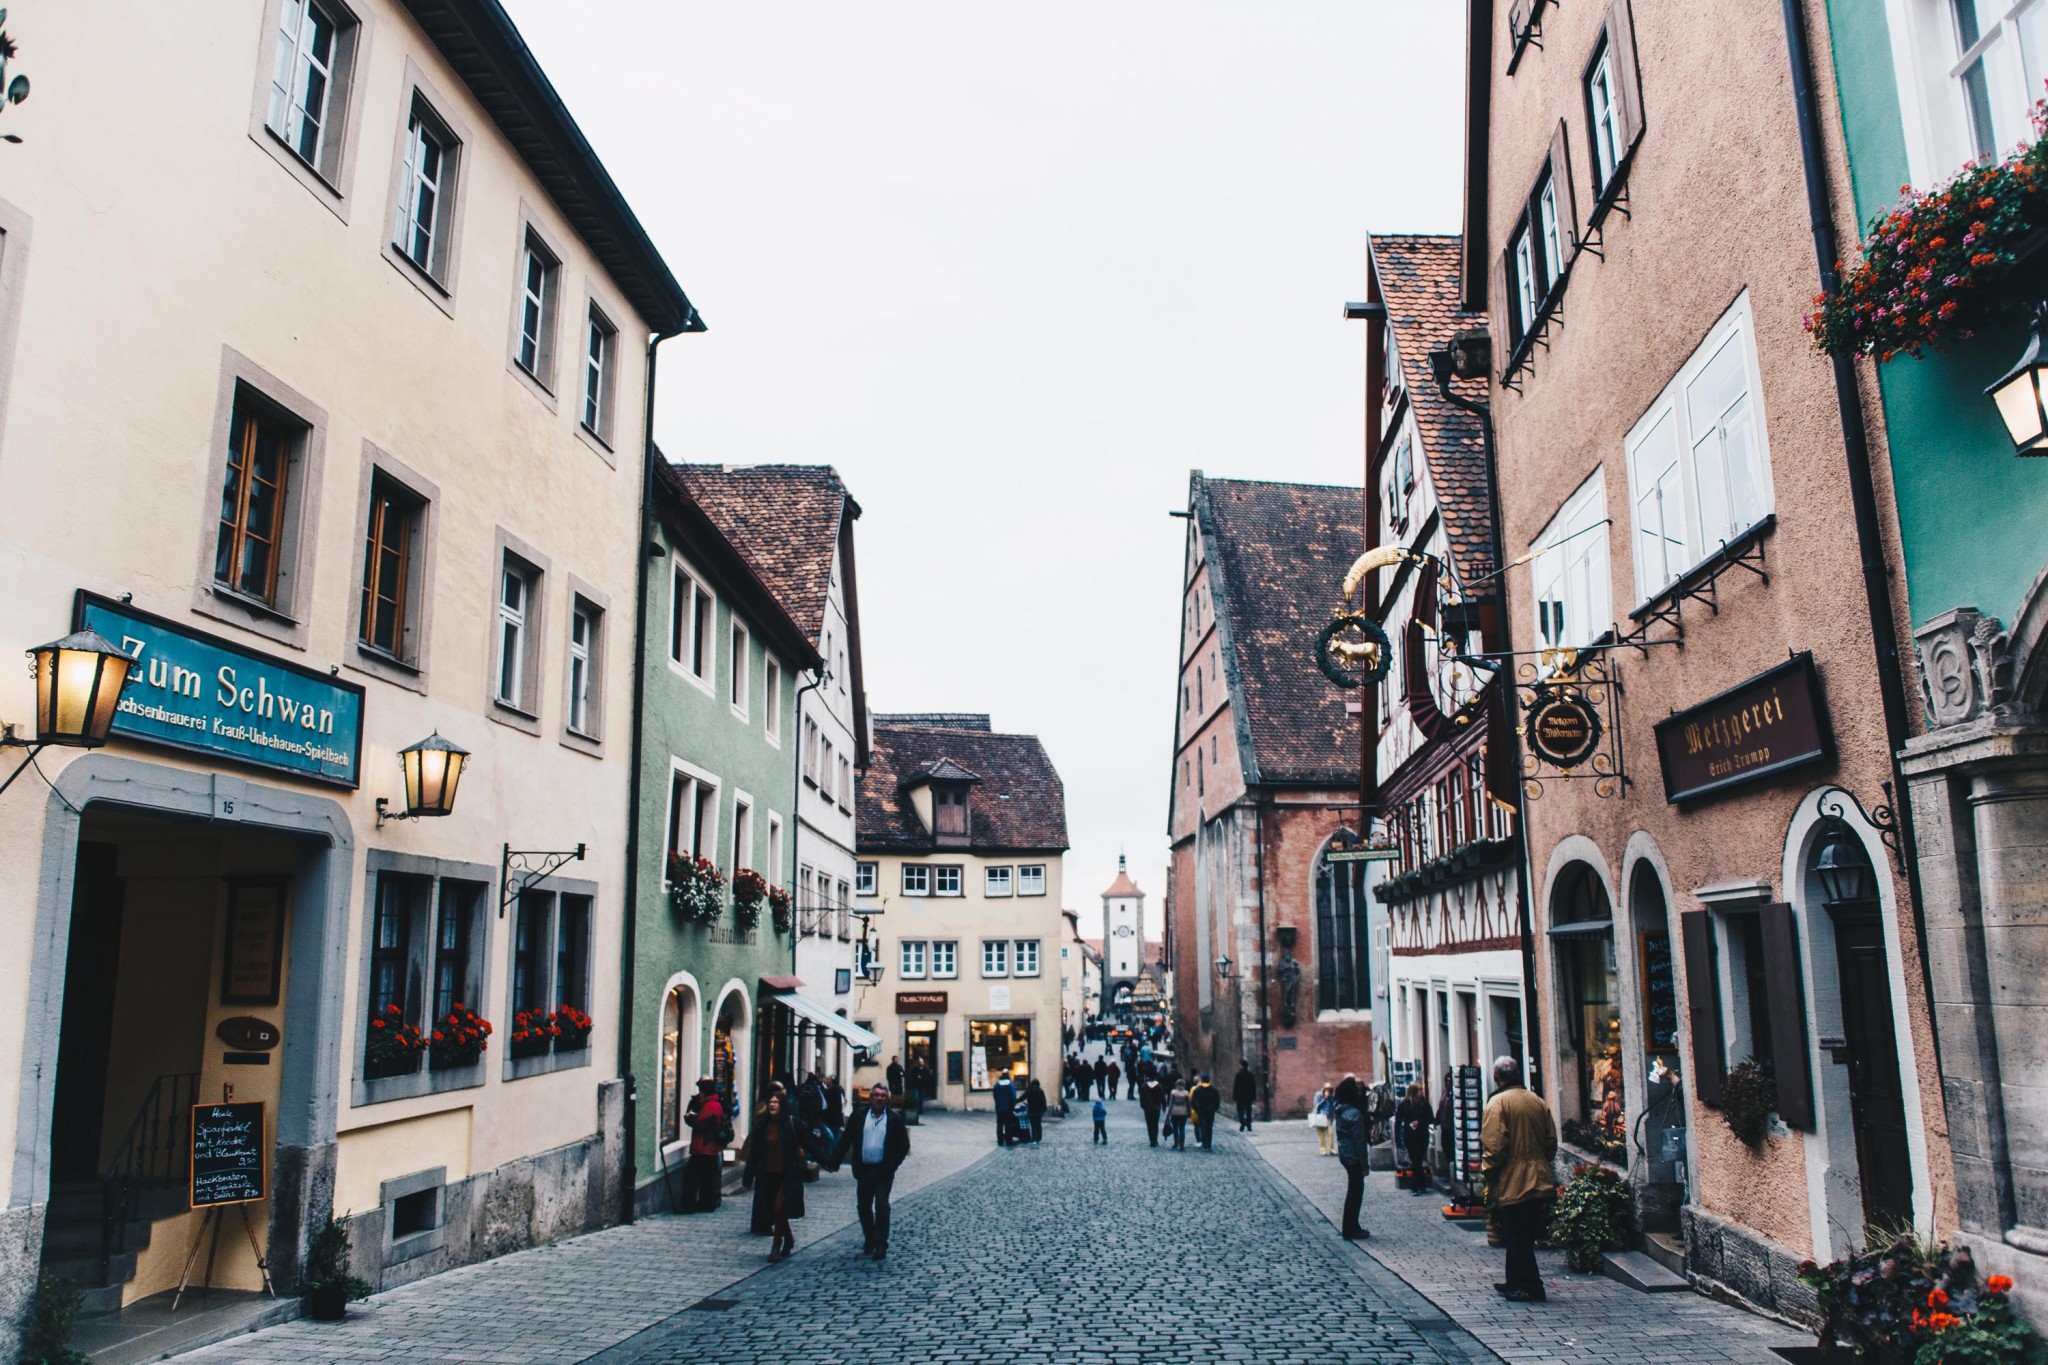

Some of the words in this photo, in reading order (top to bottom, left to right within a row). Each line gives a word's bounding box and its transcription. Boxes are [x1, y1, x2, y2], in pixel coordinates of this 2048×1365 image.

[121, 635, 200, 699] Zum
[217, 666, 333, 734] Schwan
[1684, 687, 1784, 755] Metzgerei
[223, 800, 234, 814] 15
[196, 1138, 214, 1149] mit
[195, 1148, 211, 1159] und
